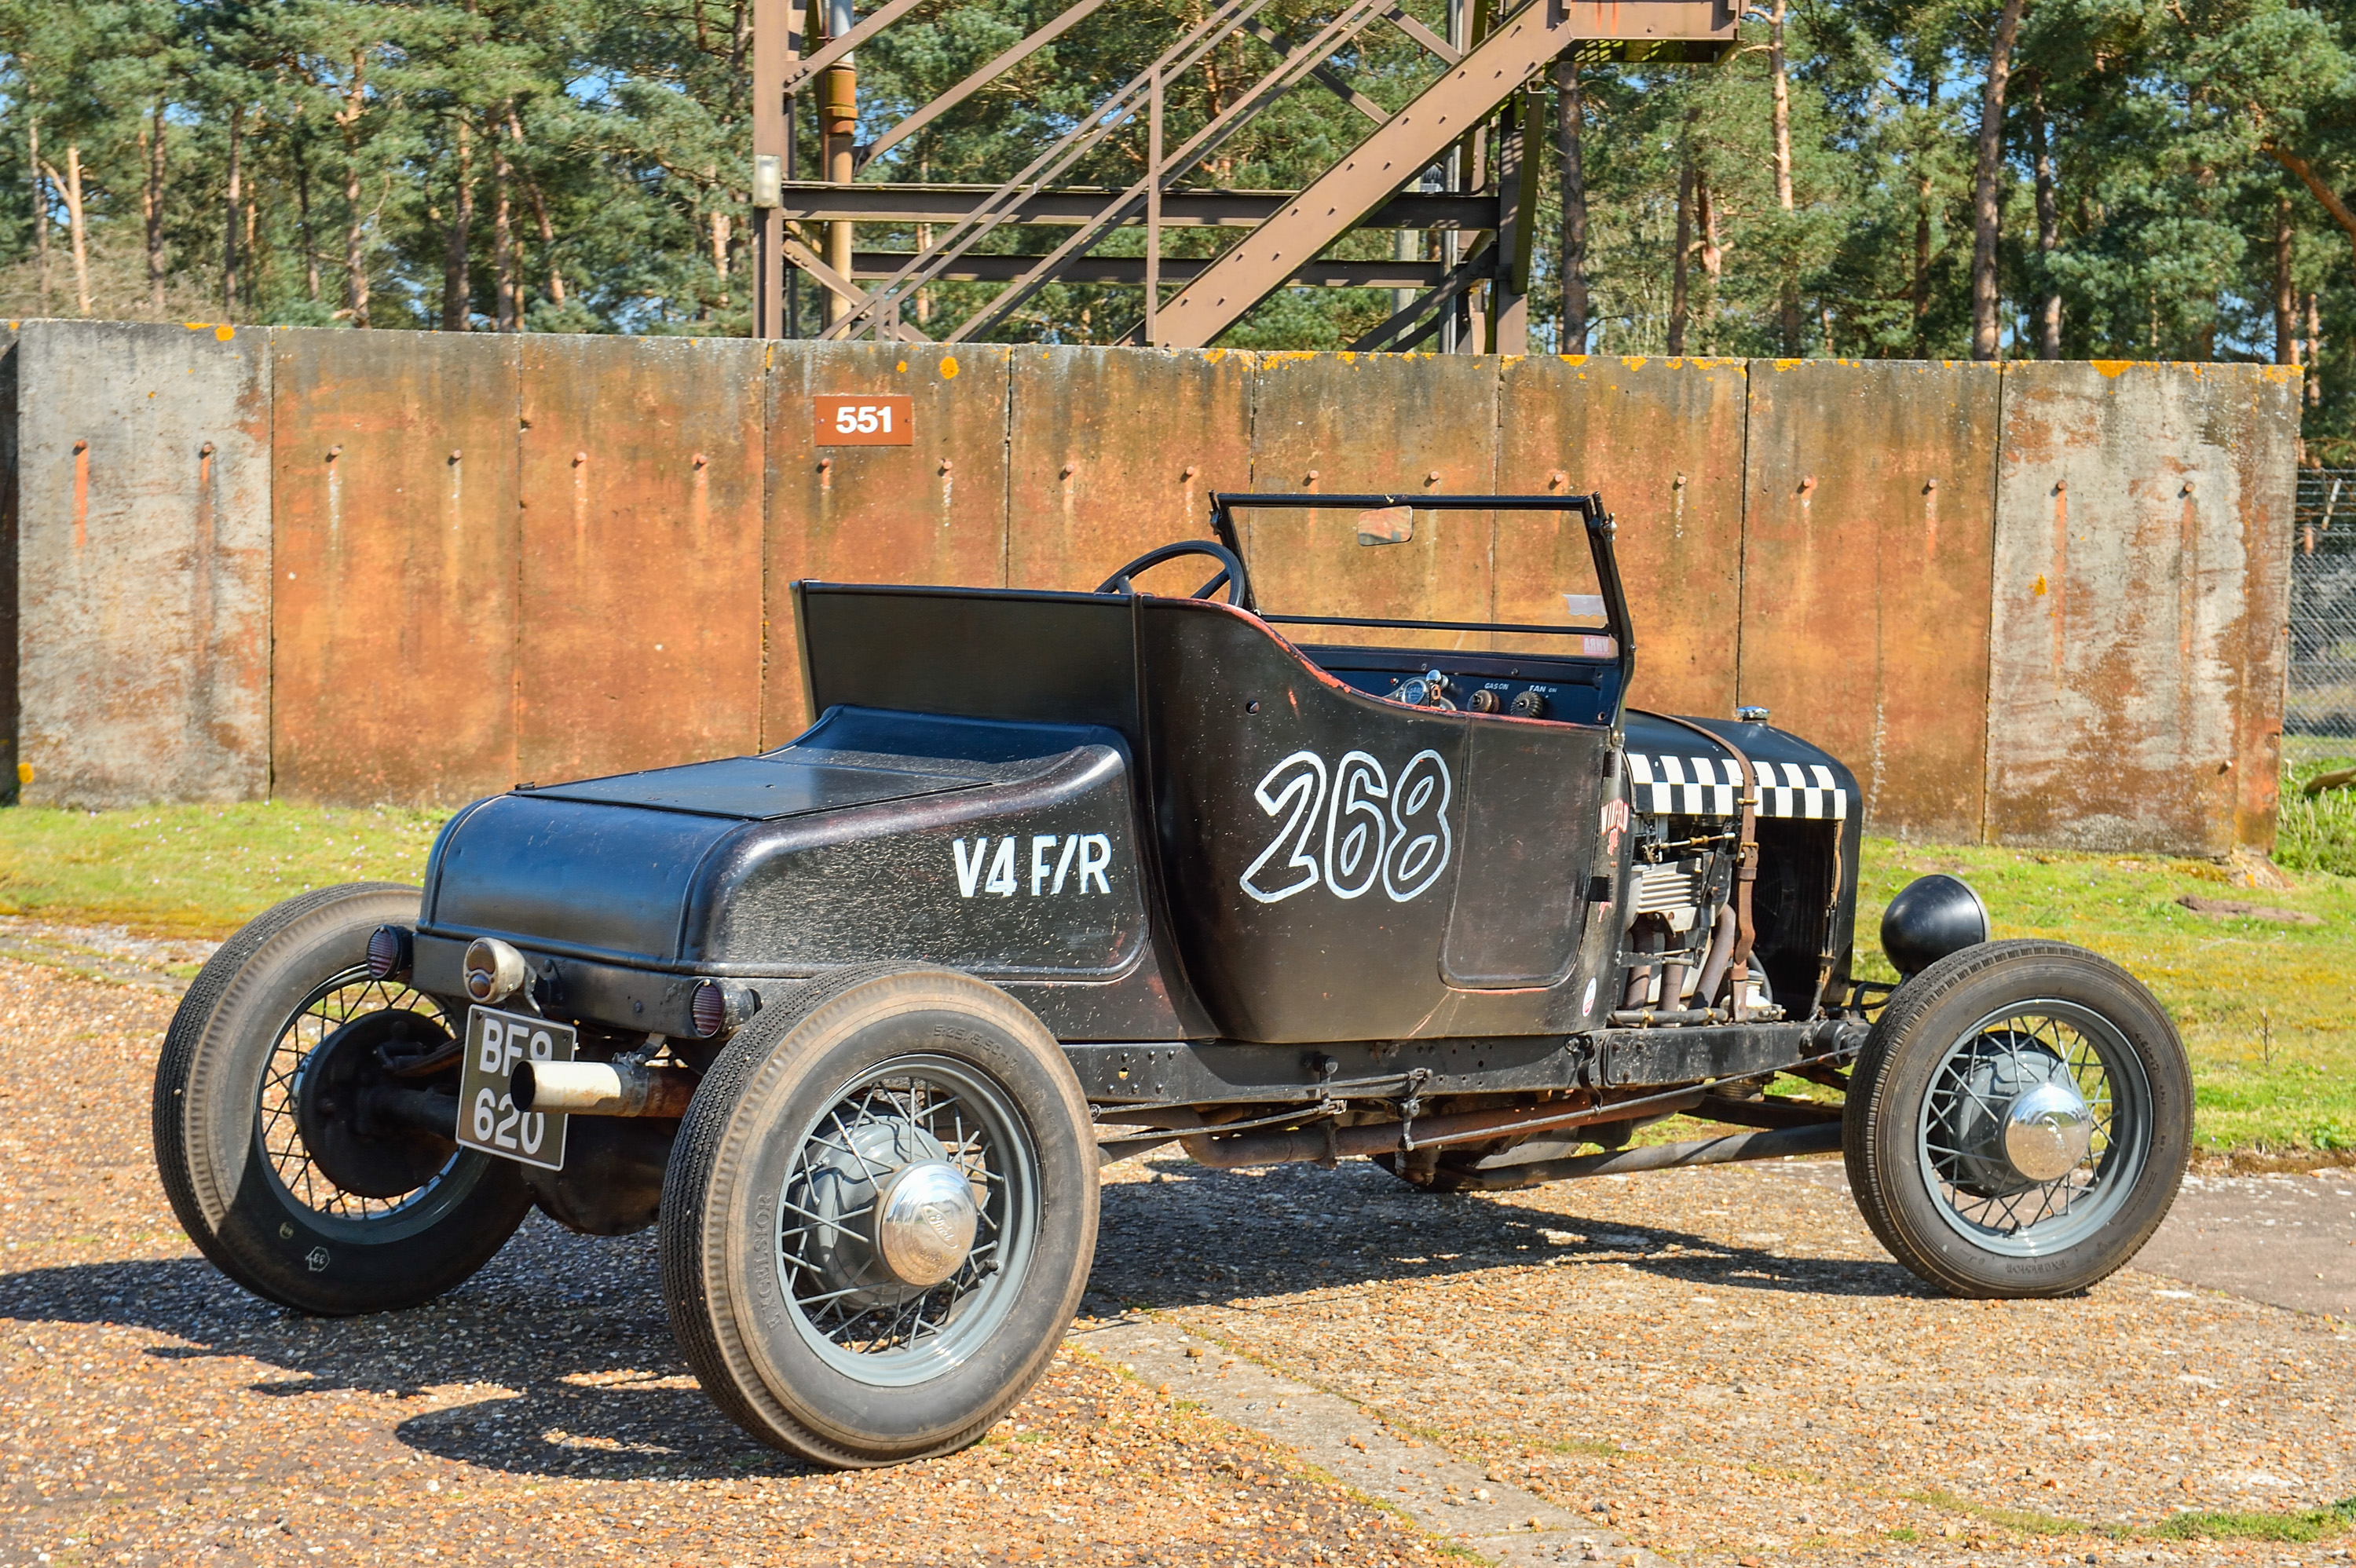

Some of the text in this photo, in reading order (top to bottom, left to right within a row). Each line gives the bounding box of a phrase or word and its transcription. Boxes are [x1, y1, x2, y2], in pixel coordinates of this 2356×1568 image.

[836, 406, 892, 434] 551
[1238, 747, 1452, 904] 268
[952, 833, 1113, 898] V4 F/R
[474, 1087, 545, 1155] 620
[752, 1193, 784, 1334] EXCELSIOR
